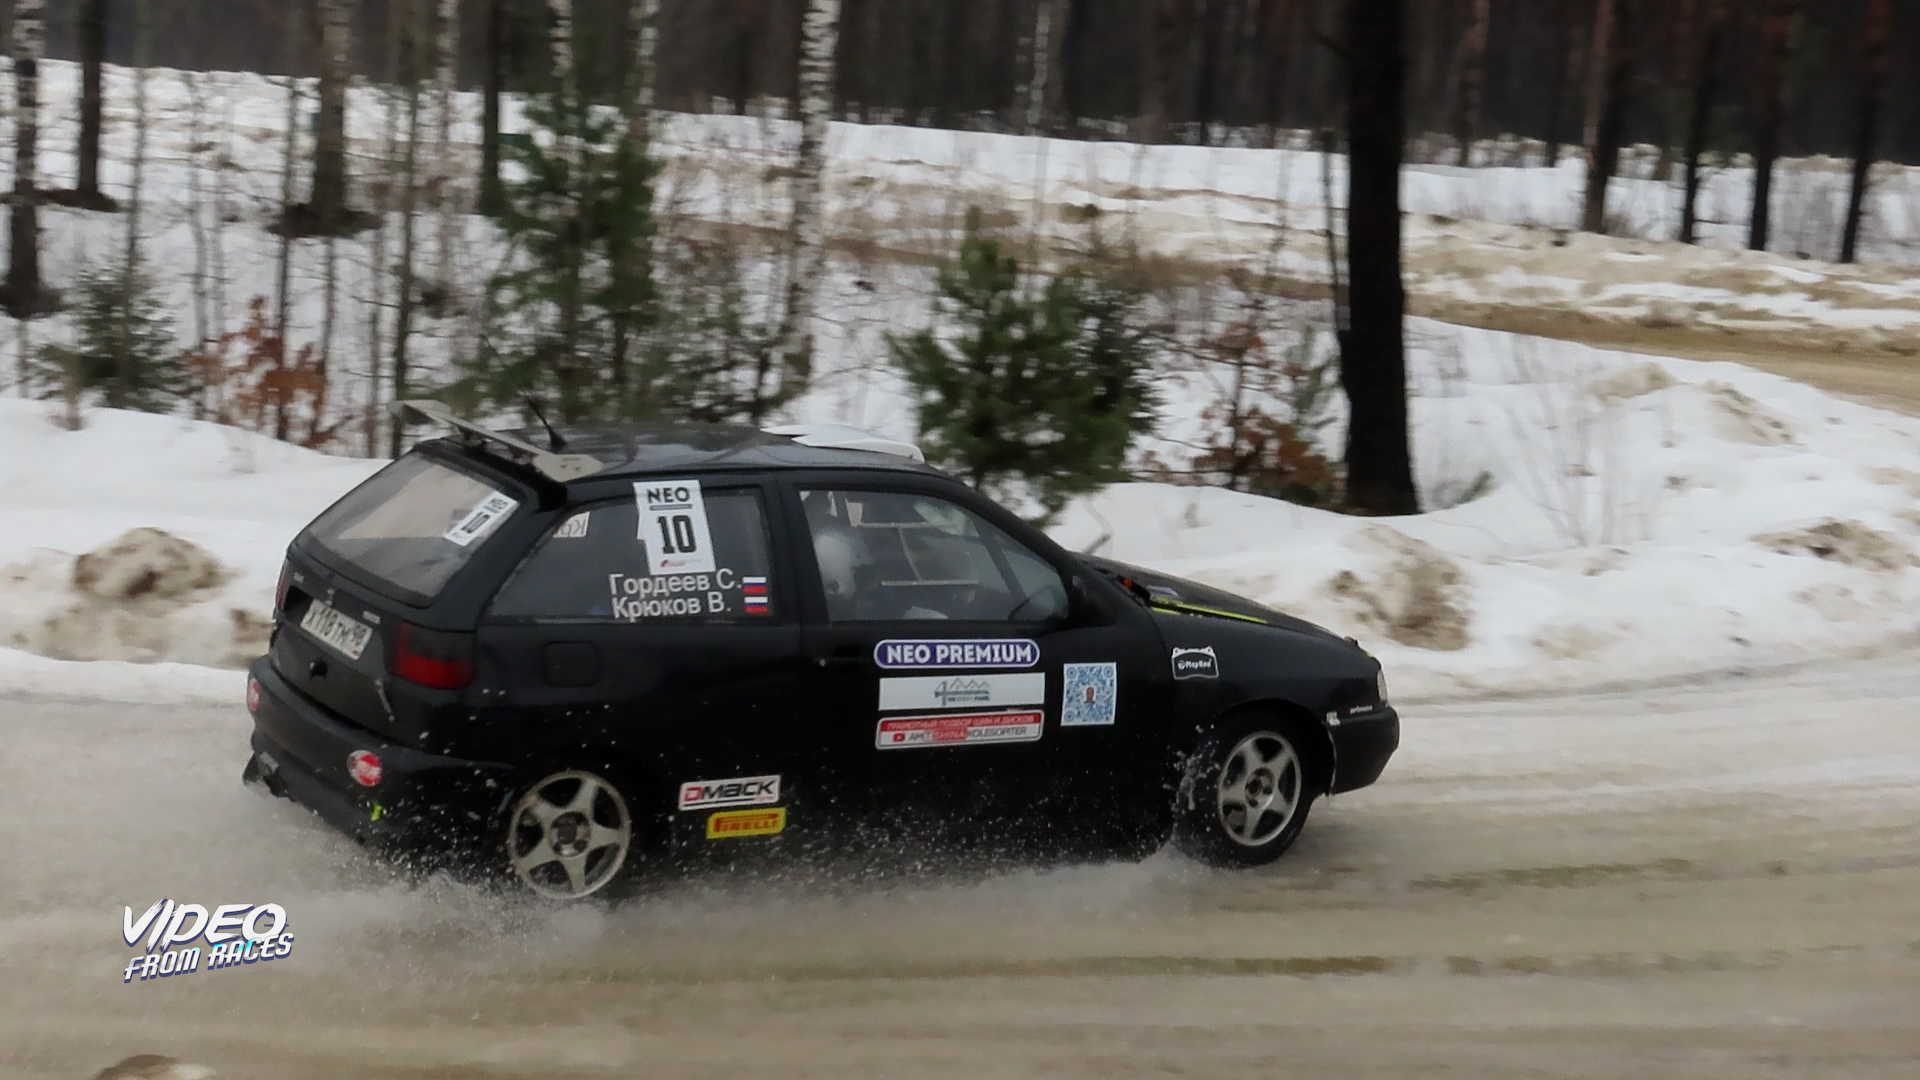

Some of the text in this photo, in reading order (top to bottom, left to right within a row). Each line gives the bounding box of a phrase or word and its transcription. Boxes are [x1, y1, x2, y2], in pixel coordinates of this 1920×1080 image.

[648, 487, 690, 503] NEO
[461, 511, 491, 534] 10
[656, 515, 697, 554] 10
[608, 568, 742, 599] Гордеев С.
[611, 591, 731, 622] Крюков В.
[886, 643, 1032, 664] NEO PREMIUM
